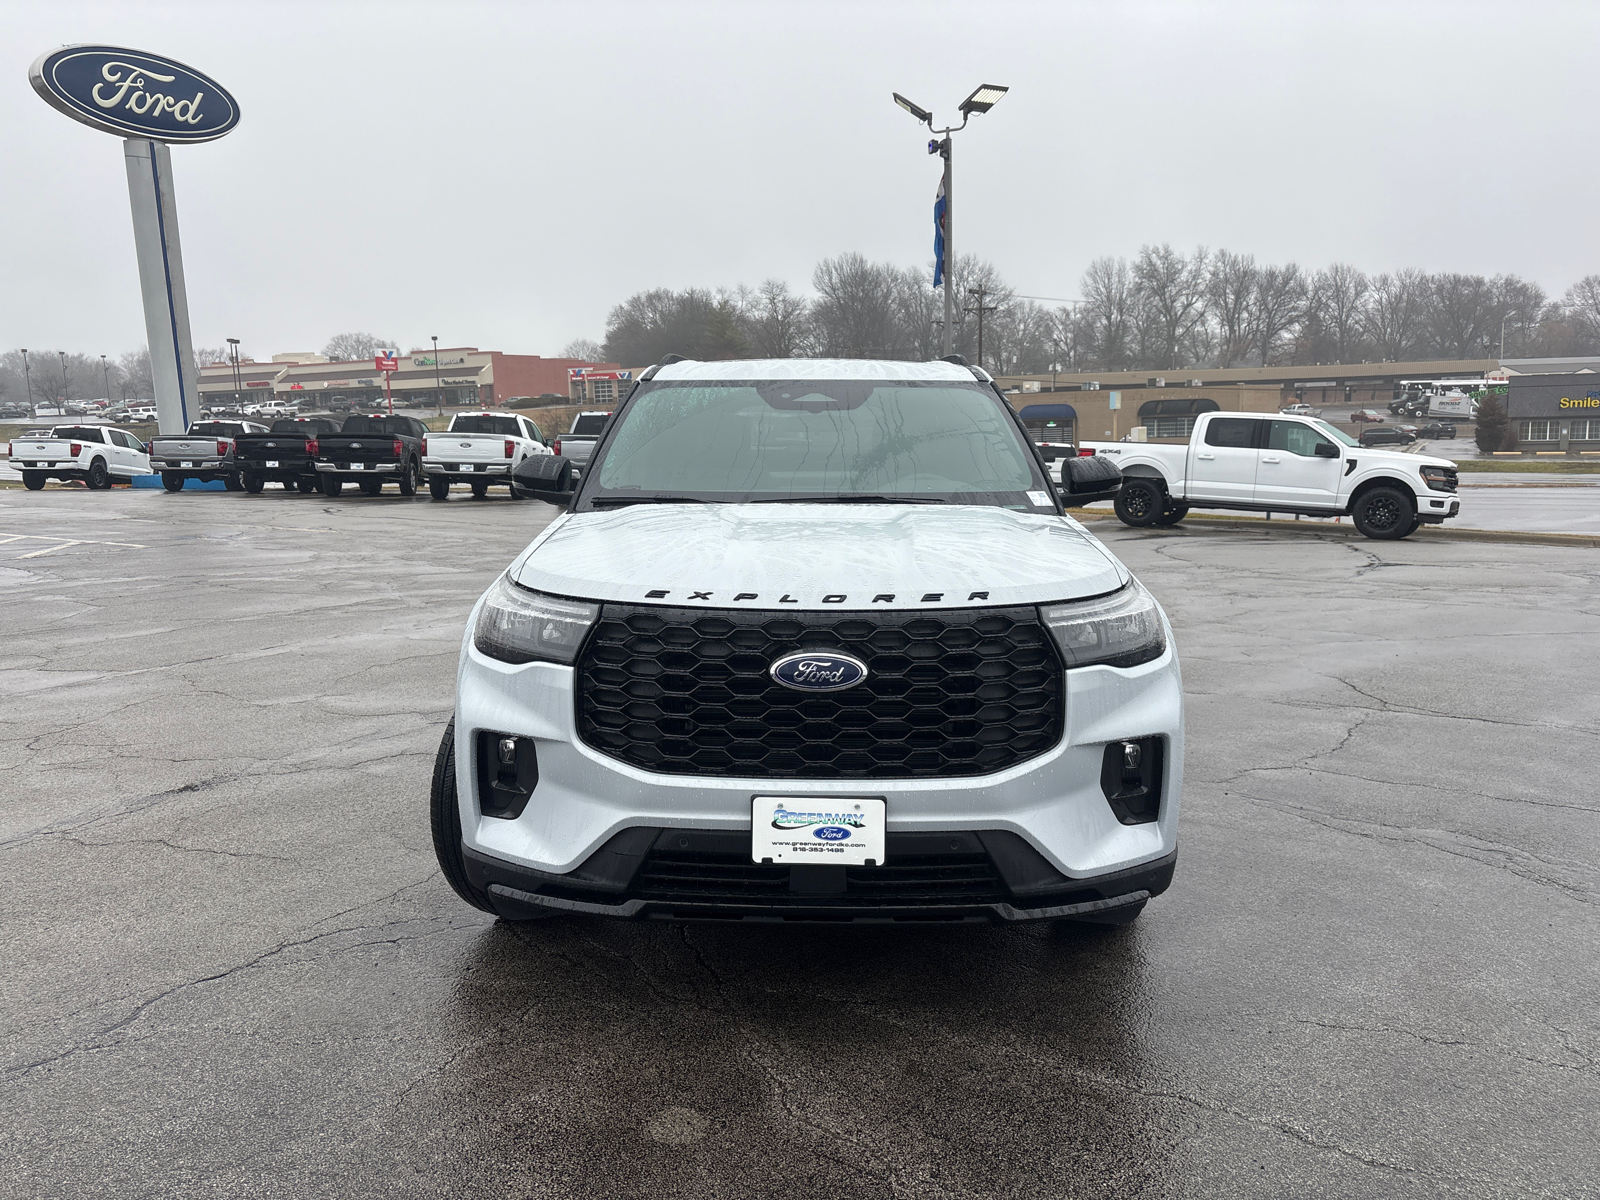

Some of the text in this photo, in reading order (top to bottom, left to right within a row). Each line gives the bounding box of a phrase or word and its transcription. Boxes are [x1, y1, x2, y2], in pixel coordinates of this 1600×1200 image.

[91, 61, 204, 126] Ford
[644, 589, 990, 605] EXPLORER
[792, 660, 845, 683] Ford
[774, 809, 865, 825] GREENWAY
[821, 828, 844, 838] Ford
